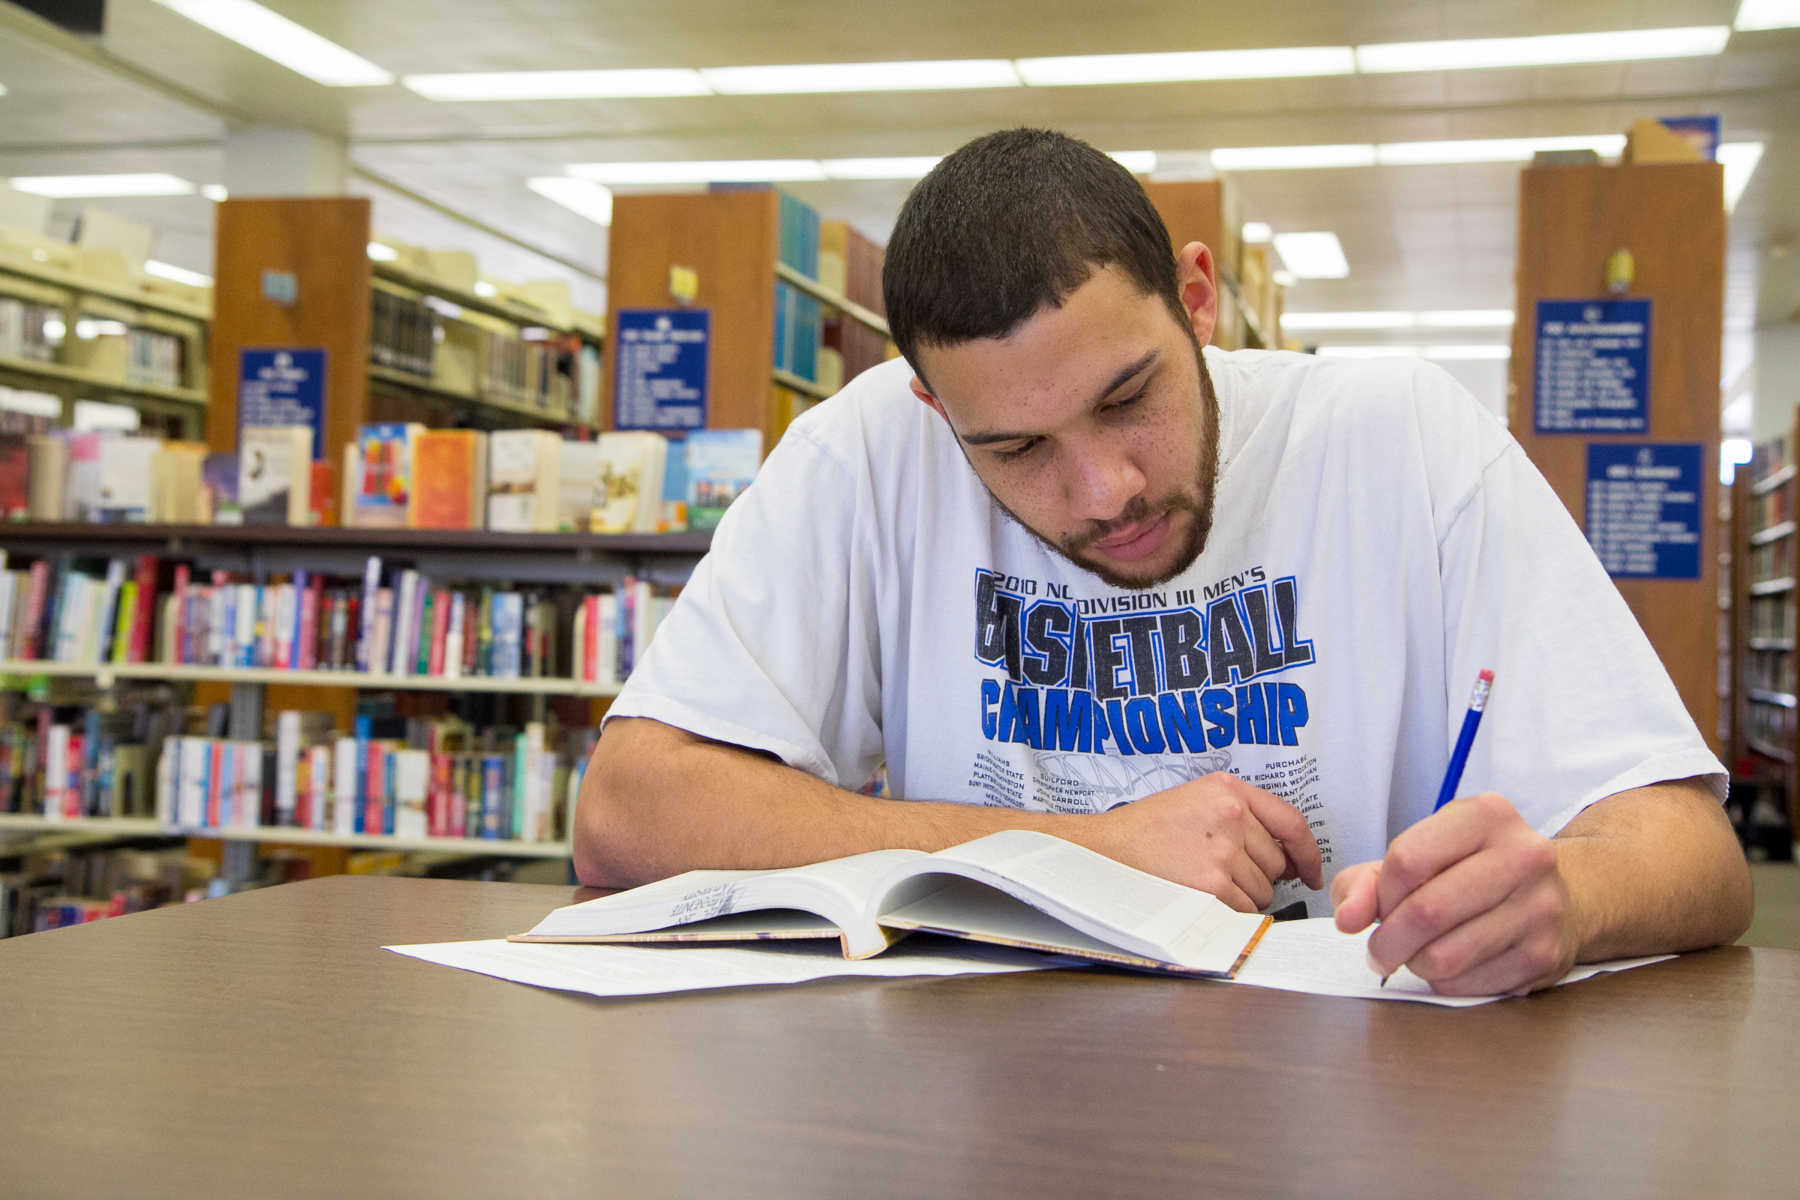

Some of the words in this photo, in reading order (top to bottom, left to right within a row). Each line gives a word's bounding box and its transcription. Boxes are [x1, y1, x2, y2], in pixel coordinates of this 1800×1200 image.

[993, 572, 1038, 596] 2010
[1077, 592, 1167, 617] DIVISION
[1176, 589, 1196, 606] III
[1203, 565, 1267, 601] MEN'S
[1265, 754, 1308, 770] PURCHASE
[1005, 769, 1024, 780] STATE
[1040, 773, 1079, 787] GUILFORD
[1254, 770, 1286, 781] RICHARD
[1006, 788, 1023, 800] STATE
[1064, 786, 1095, 797] NEWPORT
[1051, 793, 1089, 806] CARROLL
